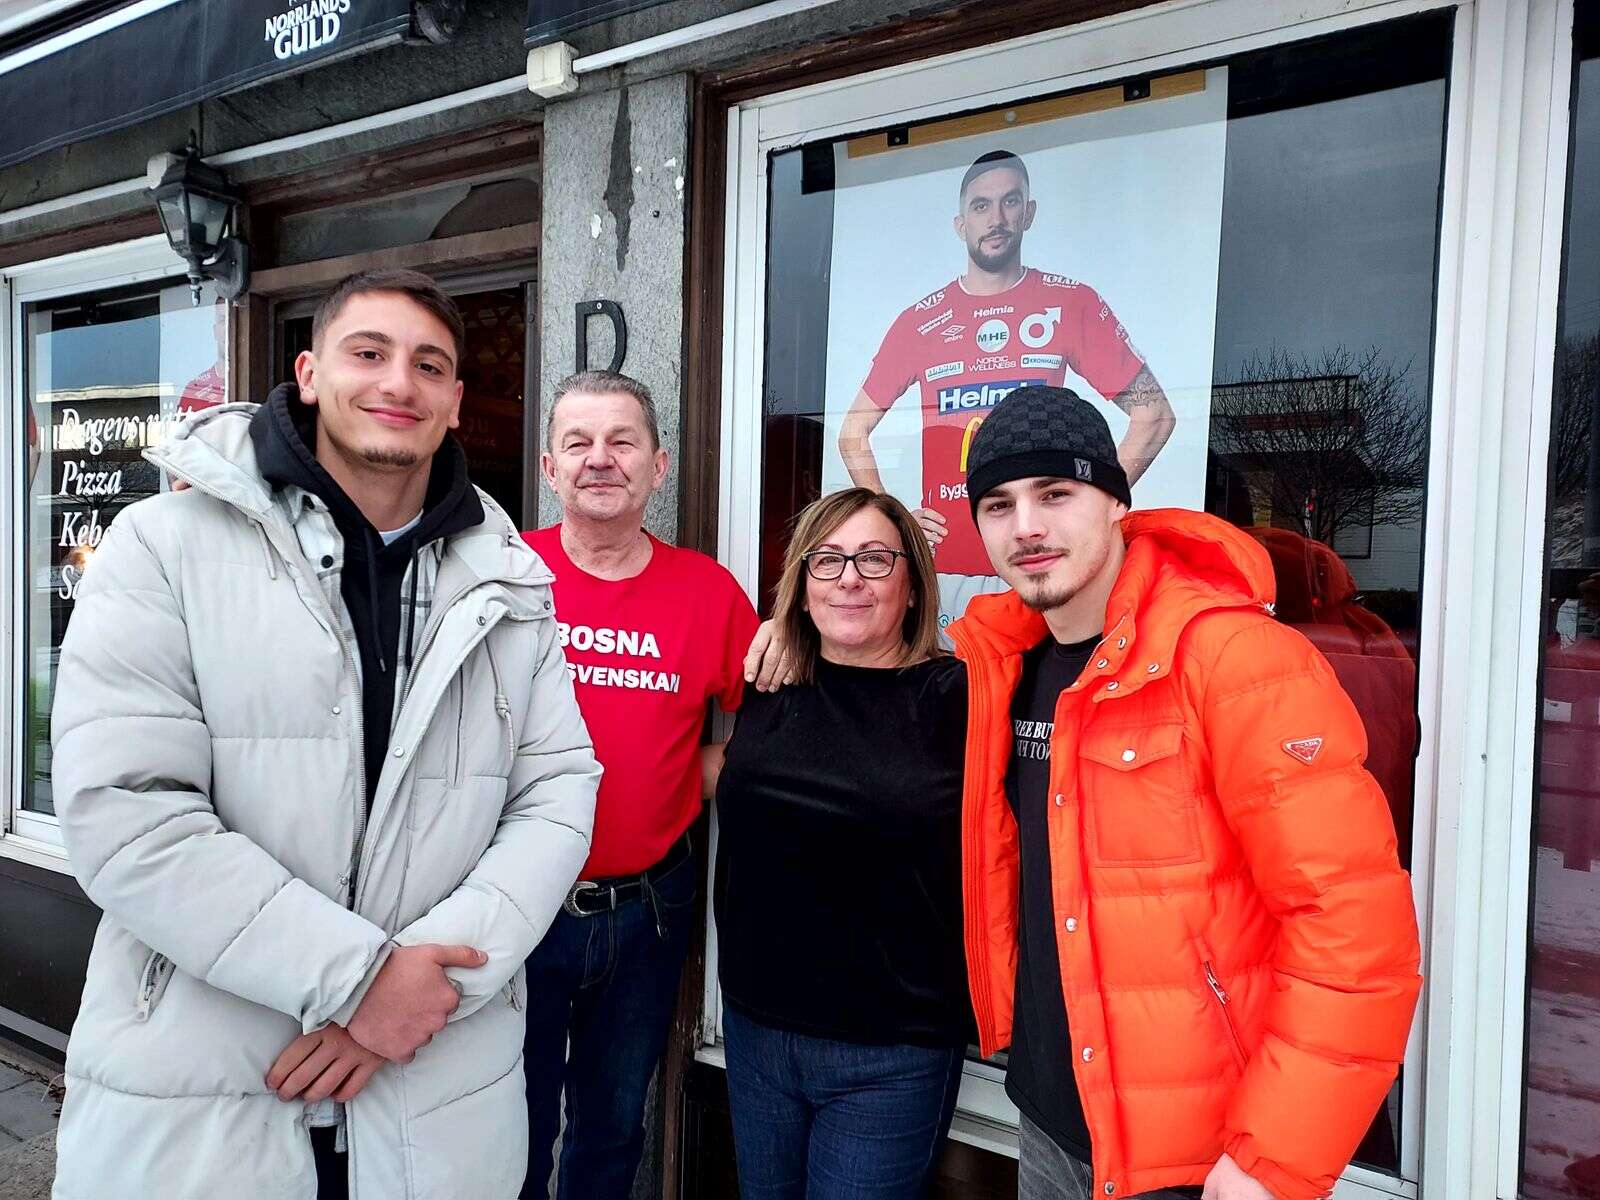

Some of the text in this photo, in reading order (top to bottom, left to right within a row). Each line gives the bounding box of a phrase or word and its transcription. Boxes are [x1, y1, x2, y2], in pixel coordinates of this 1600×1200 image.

[264, 0, 350, 41] NORRLANDS
[274, 12, 340, 60] GULD
[973, 305, 1015, 318] Helmia
[939, 382, 1028, 413] Helm
[62, 408, 140, 455] Dagens
[58, 460, 123, 496] Pizza
[557, 622, 662, 658] BOSNA
